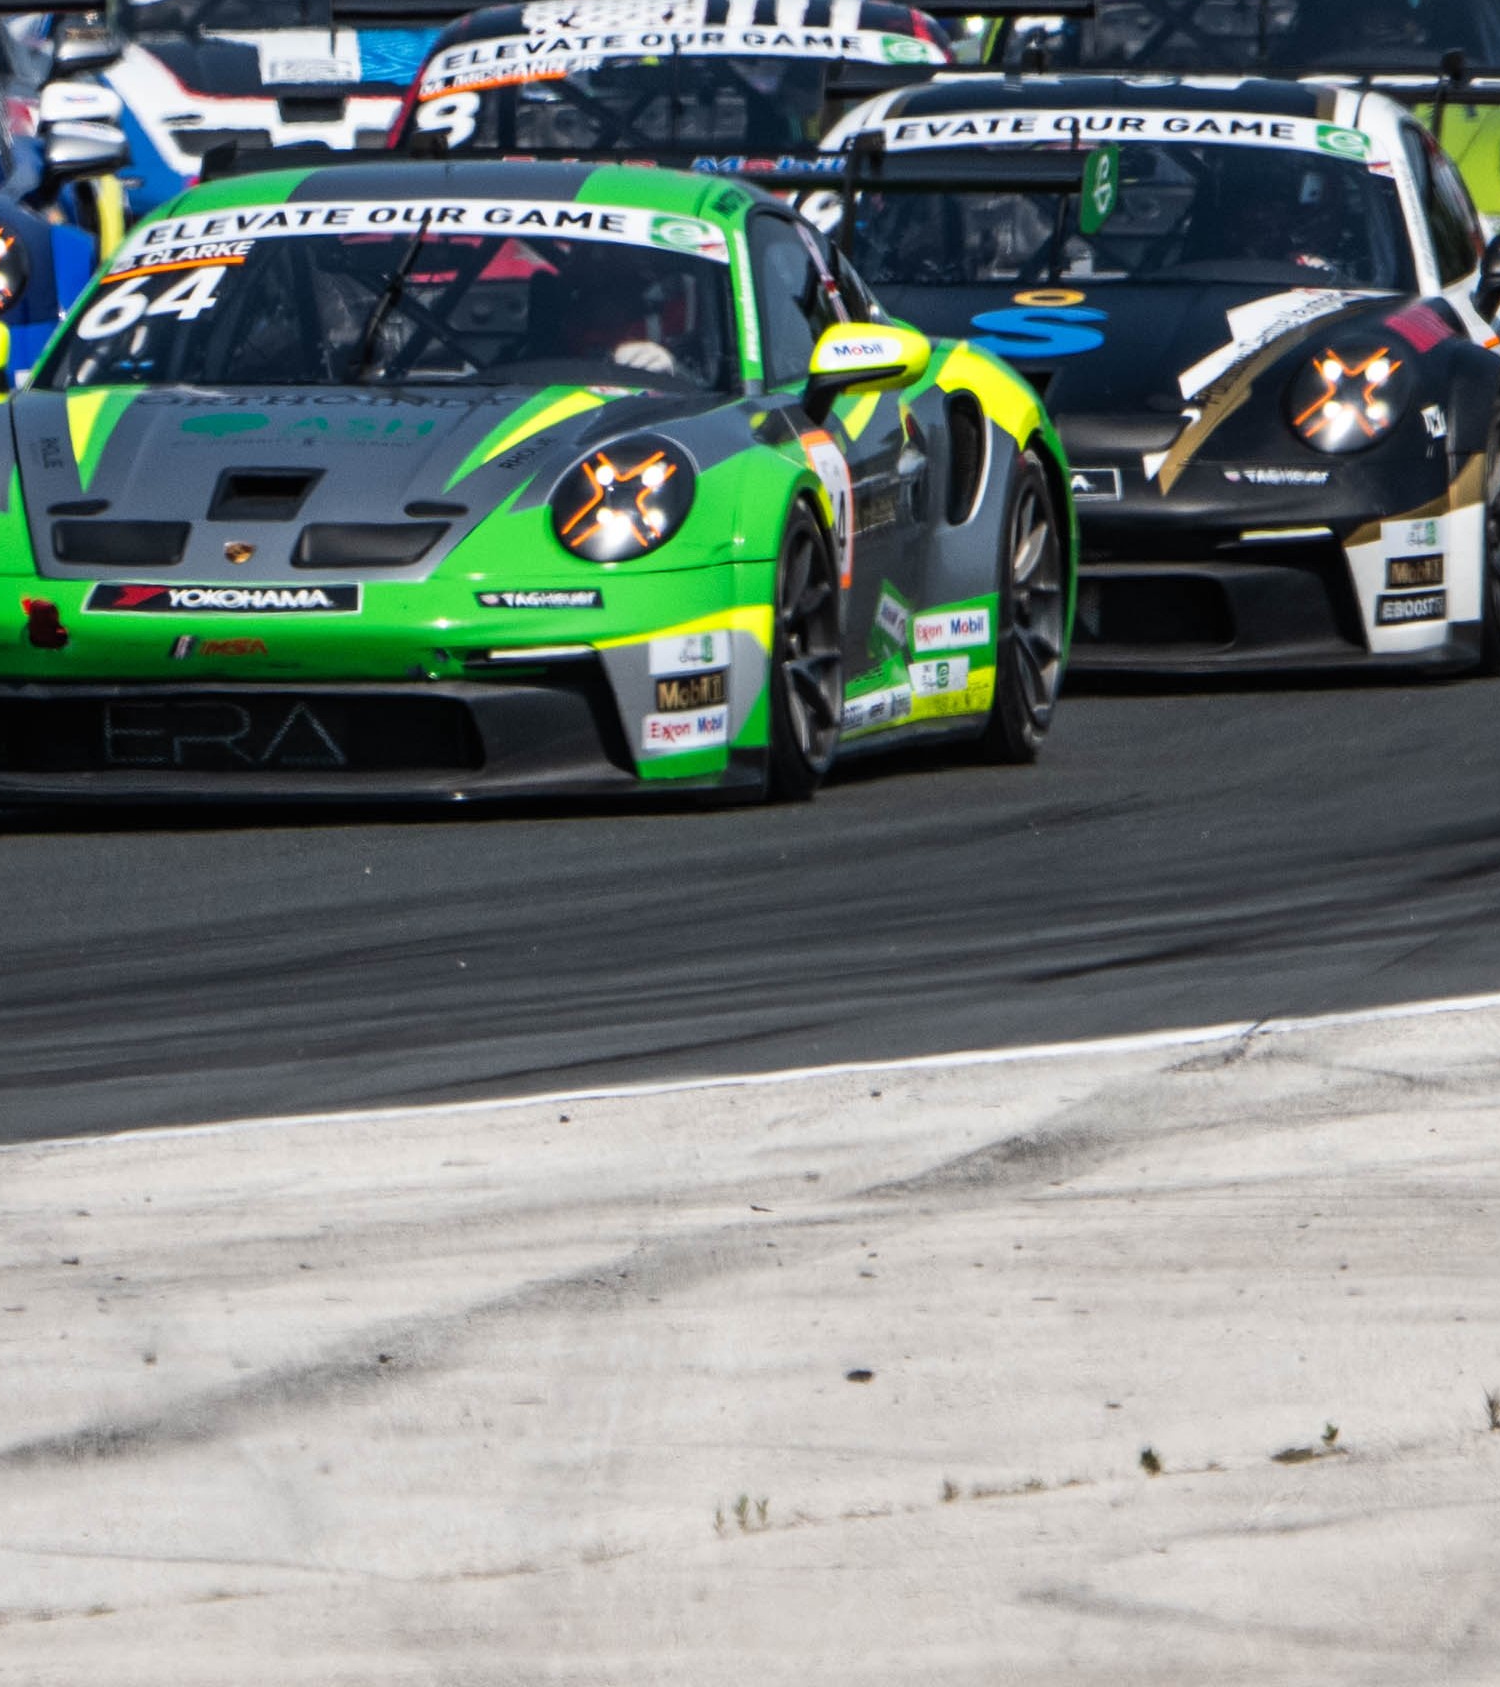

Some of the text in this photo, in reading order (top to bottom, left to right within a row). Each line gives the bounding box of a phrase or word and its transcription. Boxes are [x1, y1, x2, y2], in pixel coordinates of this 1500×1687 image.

[445, 33, 862, 69] ELEVATE OUR GAME
[1052, 116, 1145, 133] OUR
[1162, 117, 1297, 140] GAME
[145, 207, 628, 247] ELEVATE OUR GAME
[143, 240, 255, 268] CLARKE
[76, 265, 228, 341] 64
[833, 343, 884, 358] Mobil
[166, 587, 329, 610] YOKOHAMA
[950, 616, 984, 635] Mobil
[659, 676, 710, 710] Mobil
[104, 702, 346, 765] ERA
[650, 714, 723, 742] Exxon Mobil
